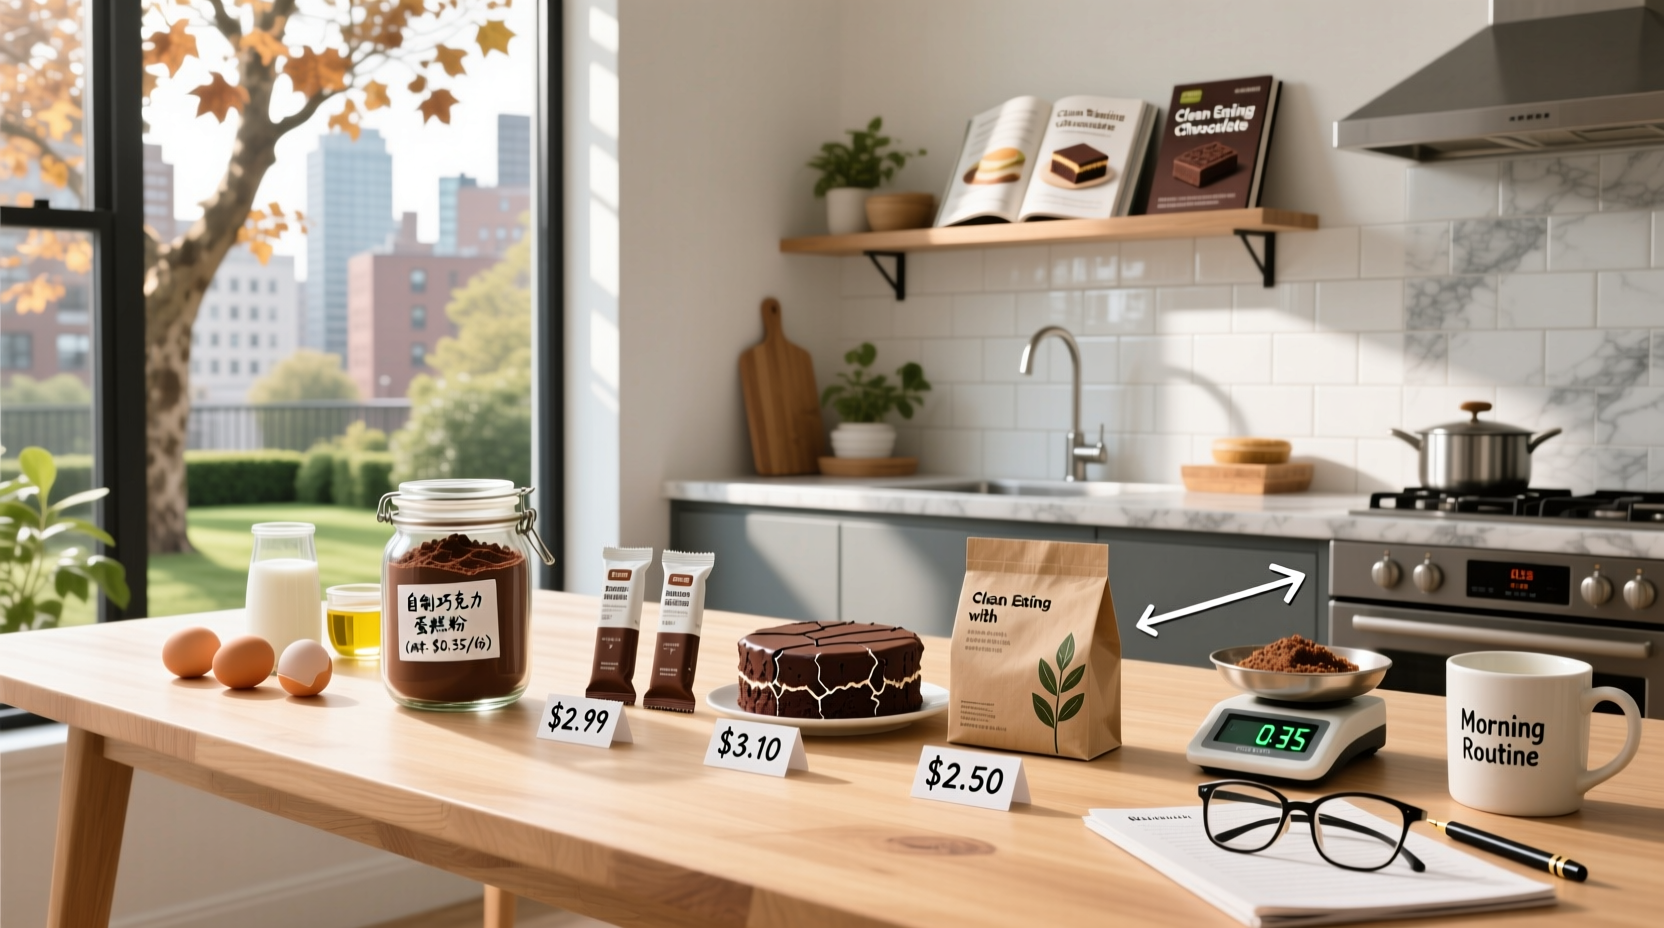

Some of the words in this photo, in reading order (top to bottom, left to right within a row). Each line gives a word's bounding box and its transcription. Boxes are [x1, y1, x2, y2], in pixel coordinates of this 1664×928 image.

[968, 608, 998, 624] with
[548, 701, 609, 734] $2.99
[1461, 707, 1546, 746] Morning
[717, 725, 782, 762] $3.10
[1255, 723, 1311, 751] 0.35
[1463, 736, 1540, 768] Routine
[925, 754, 1004, 795] $2.50
